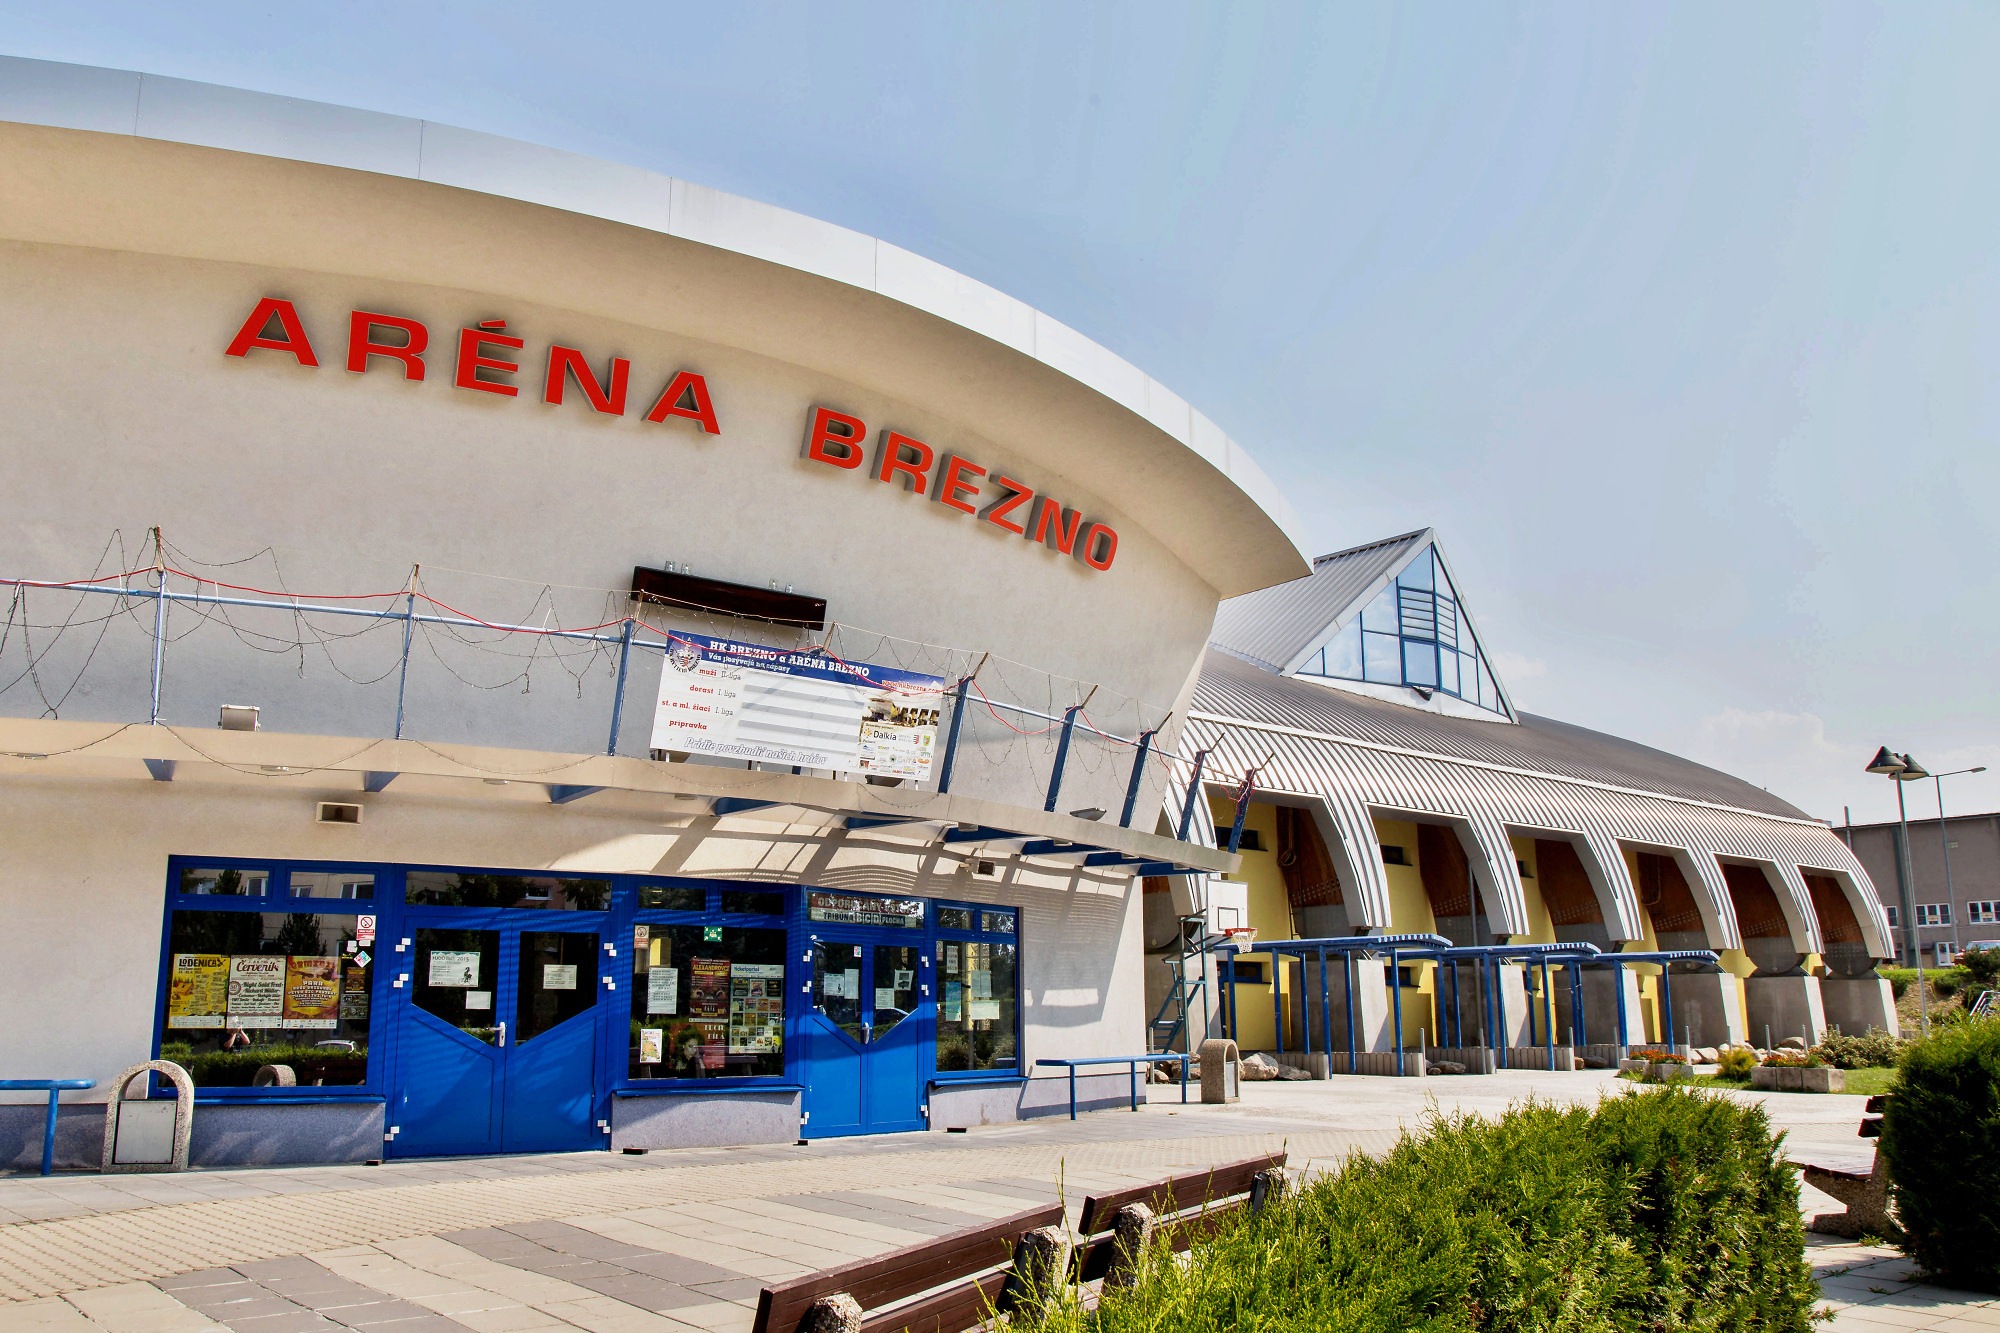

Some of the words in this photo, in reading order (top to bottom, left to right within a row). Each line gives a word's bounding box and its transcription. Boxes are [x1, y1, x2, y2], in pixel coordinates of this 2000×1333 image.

[225, 297, 721, 435] ARÉNA
[801, 405, 1118, 571] BREZNO
[729, 644, 777, 661] BREZNO
[828, 661, 870, 677] BREZNO
[689, 684, 714, 694] dorast
[873, 730, 897, 742] Dalkia
[236, 959, 279, 972] Červeník
